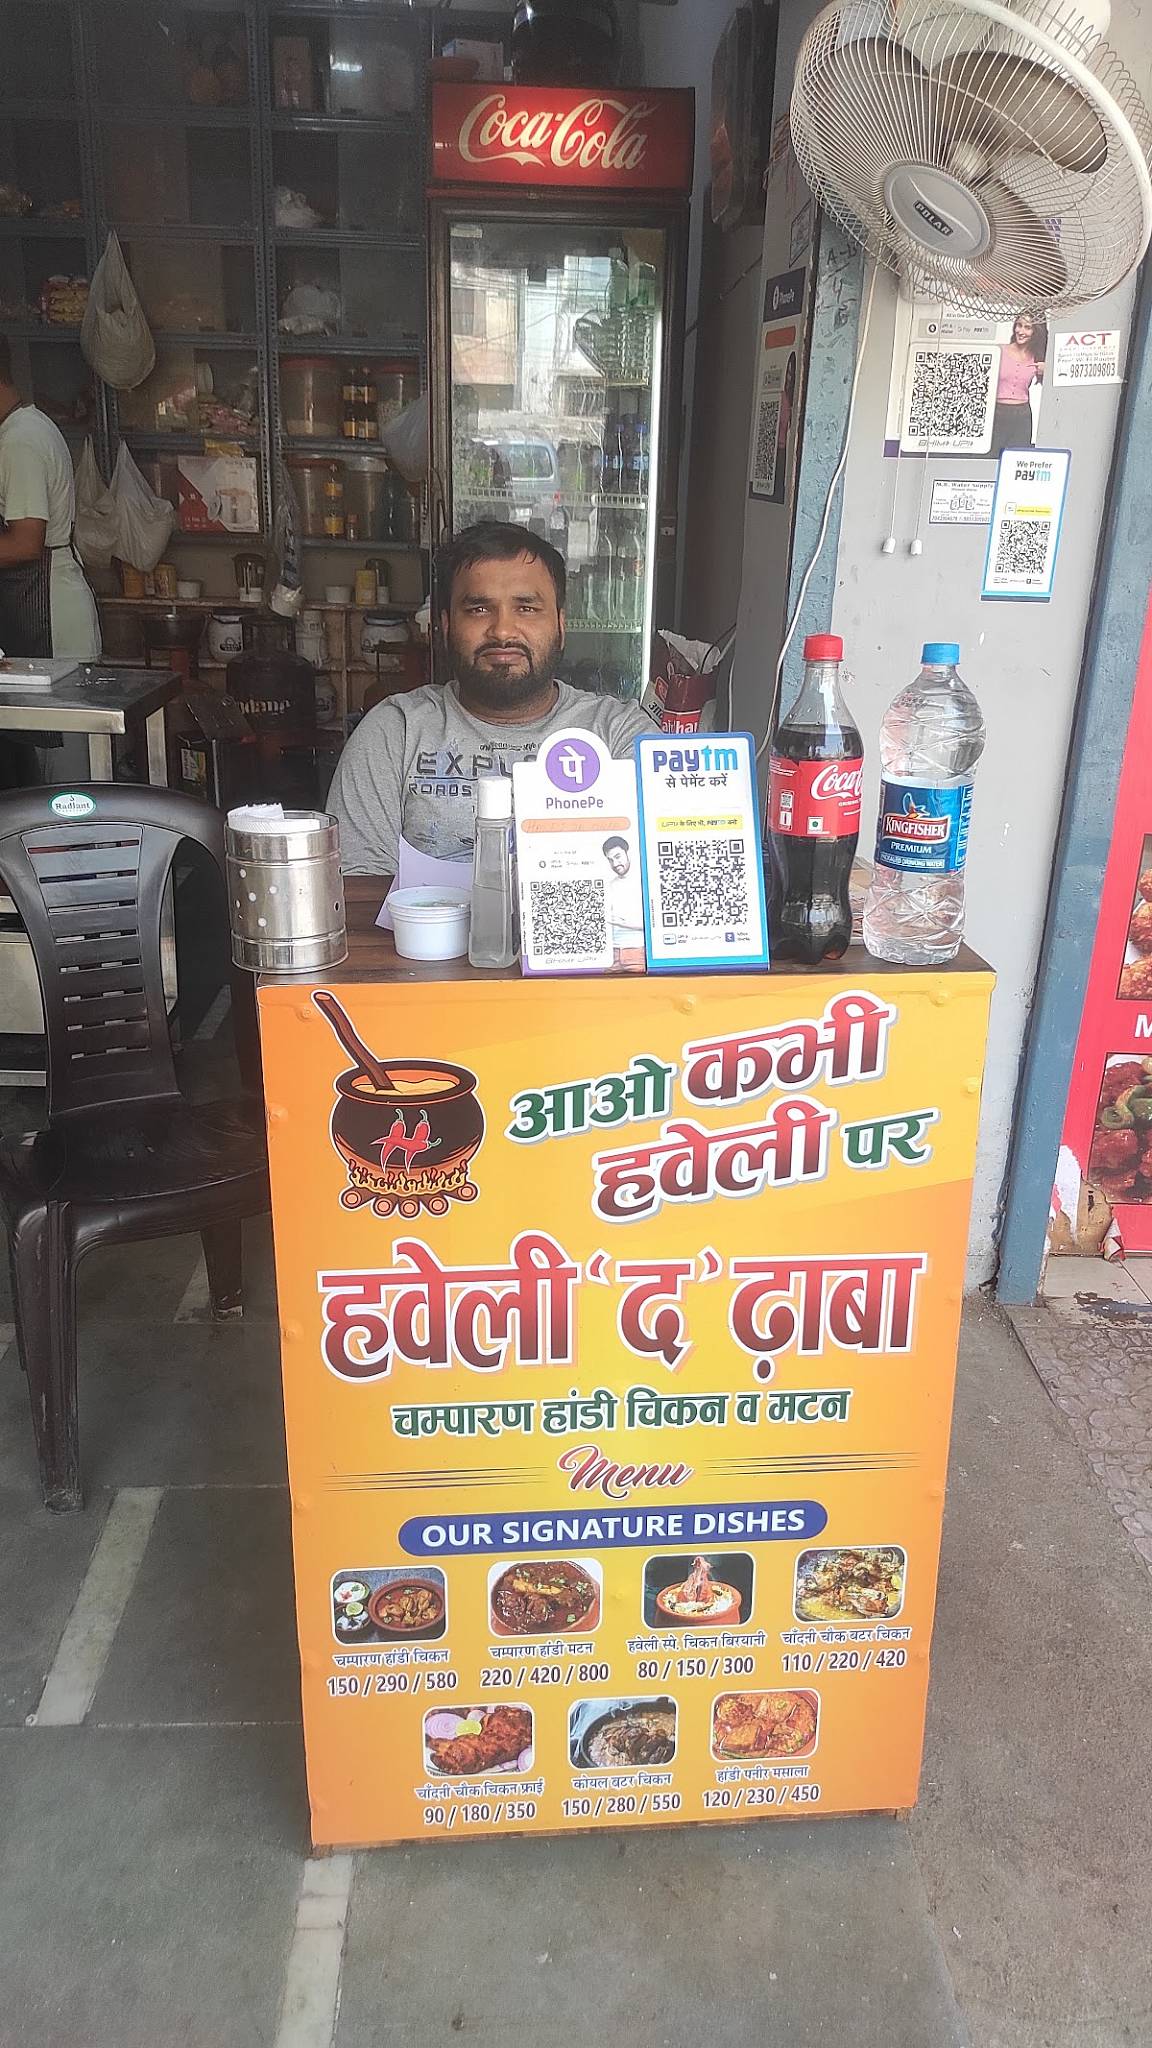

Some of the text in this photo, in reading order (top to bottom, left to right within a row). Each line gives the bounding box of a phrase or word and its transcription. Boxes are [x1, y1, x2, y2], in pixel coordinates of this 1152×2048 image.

[458, 93, 659, 170] Coca-Cola
[915, 203, 952, 236] POLAR
[1066, 333, 1112, 346] ACT
[1070, 363, 1116, 378] 9873209803
[1016, 460, 1053, 469] We Prefer
[665, 772, 729, 788] से पेमेंट करें
[55, 801, 90, 810] Radiant
[545, 796, 604, 809] PhonePe
[886, 816, 946, 837] KINGFISHER
[890, 841, 932, 854] PREMIUM
[508, 995, 890, 1140] आओ कभी
[596, 1099, 934, 1218] हवेली पर
[322, 1234, 578, 1378] हवेली
[392, 1385, 852, 1437] चम्पारण हांडी चिकन व मटन
[558, 1445, 692, 1499] Menu
[422, 1508, 805, 1548] OUR SIGNATURE DISHES
